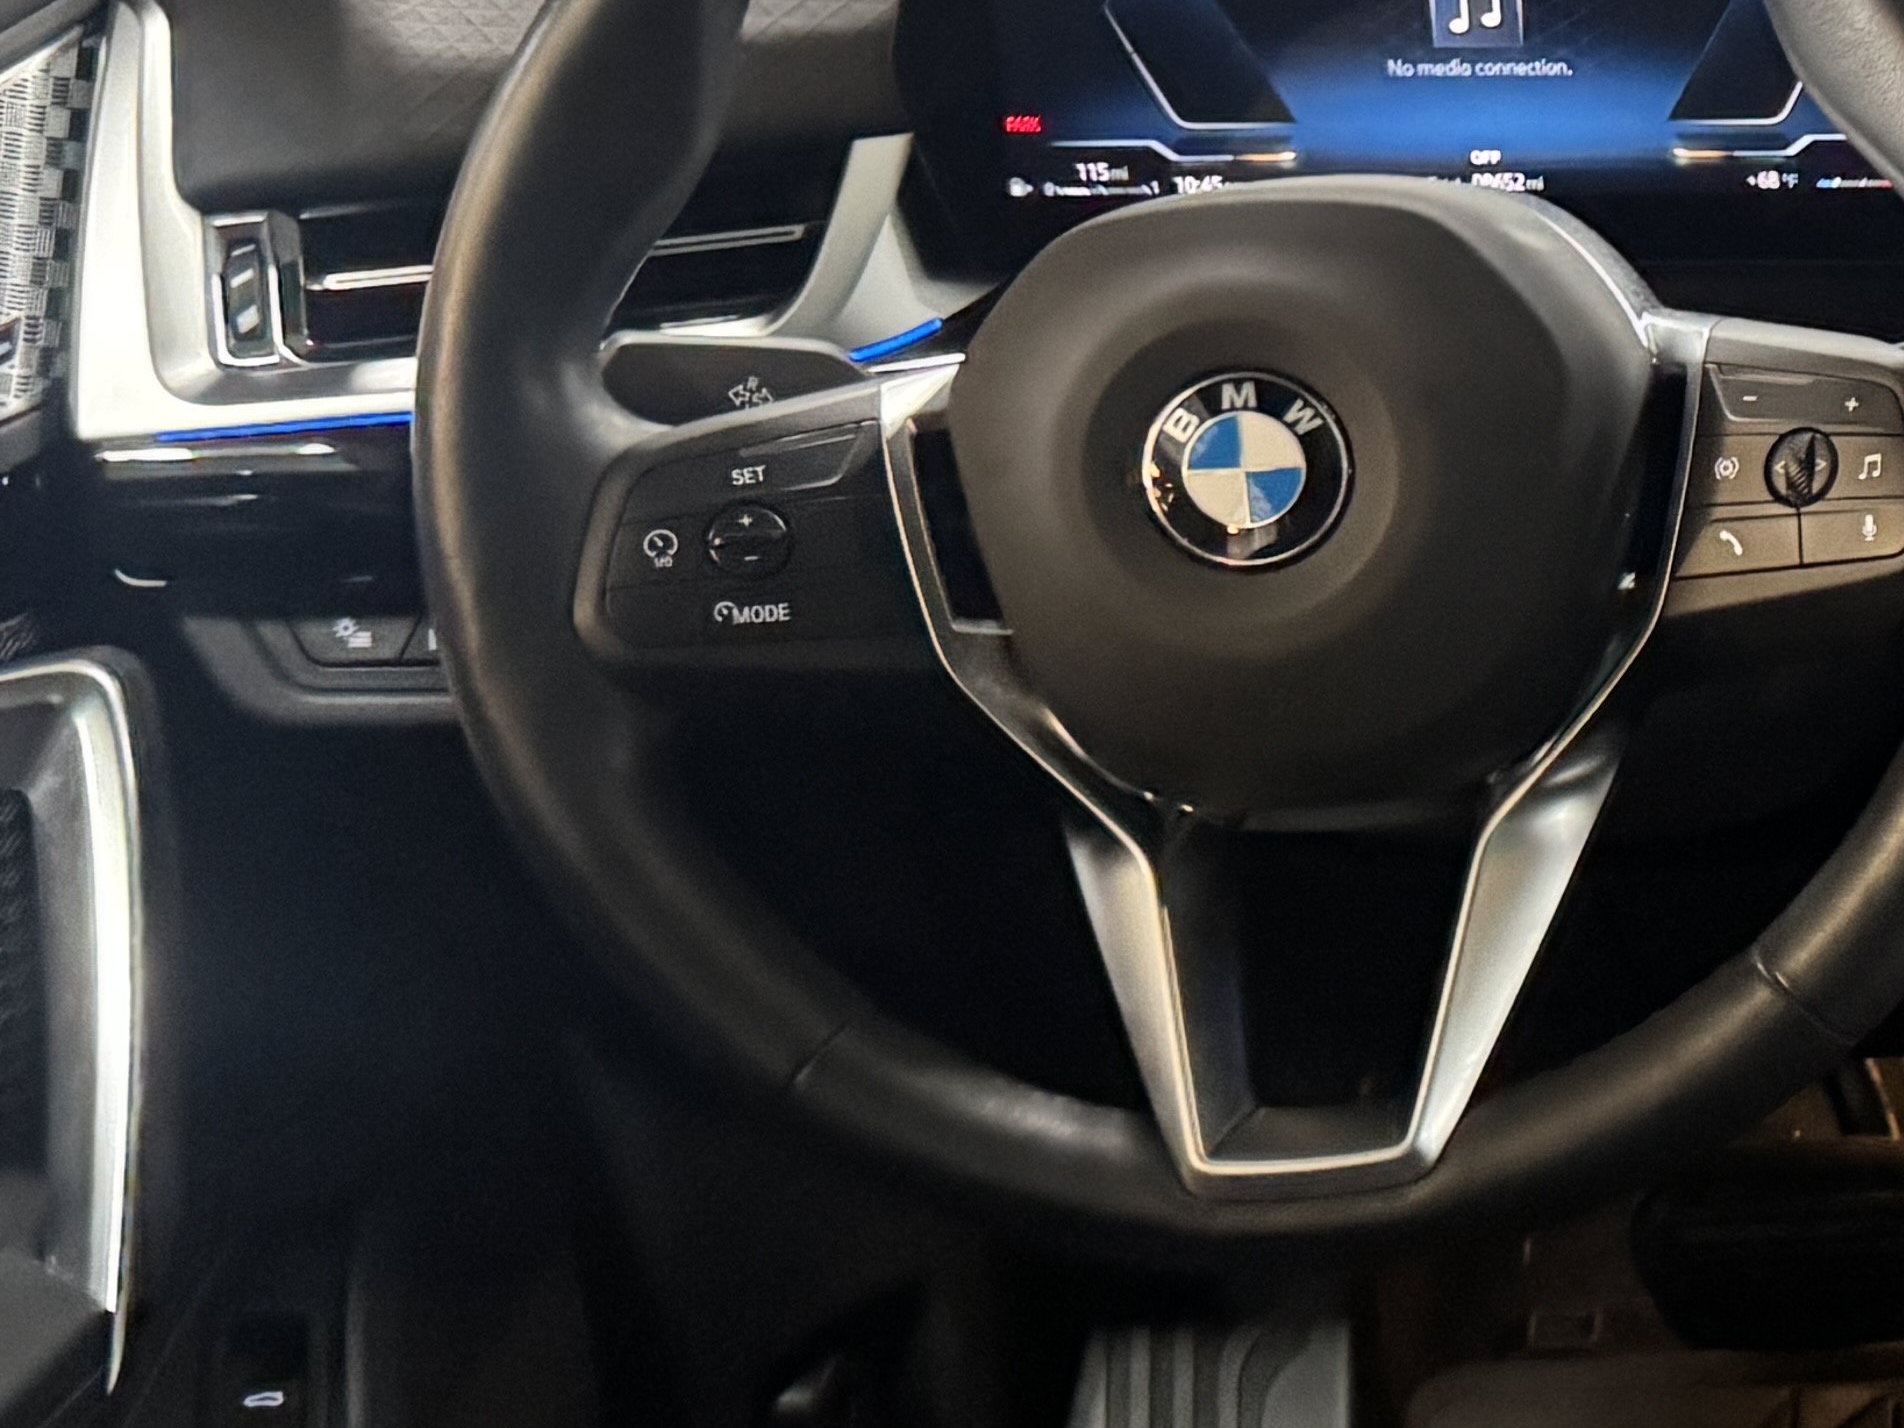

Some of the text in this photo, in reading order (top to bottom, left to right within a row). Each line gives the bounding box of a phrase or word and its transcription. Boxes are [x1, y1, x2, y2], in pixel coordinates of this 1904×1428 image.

[1386, 57, 1574, 77] No media connection.
[1163, 380, 1324, 443] BMW
[731, 465, 766, 485] SET
[732, 602, 792, 624] MODE
